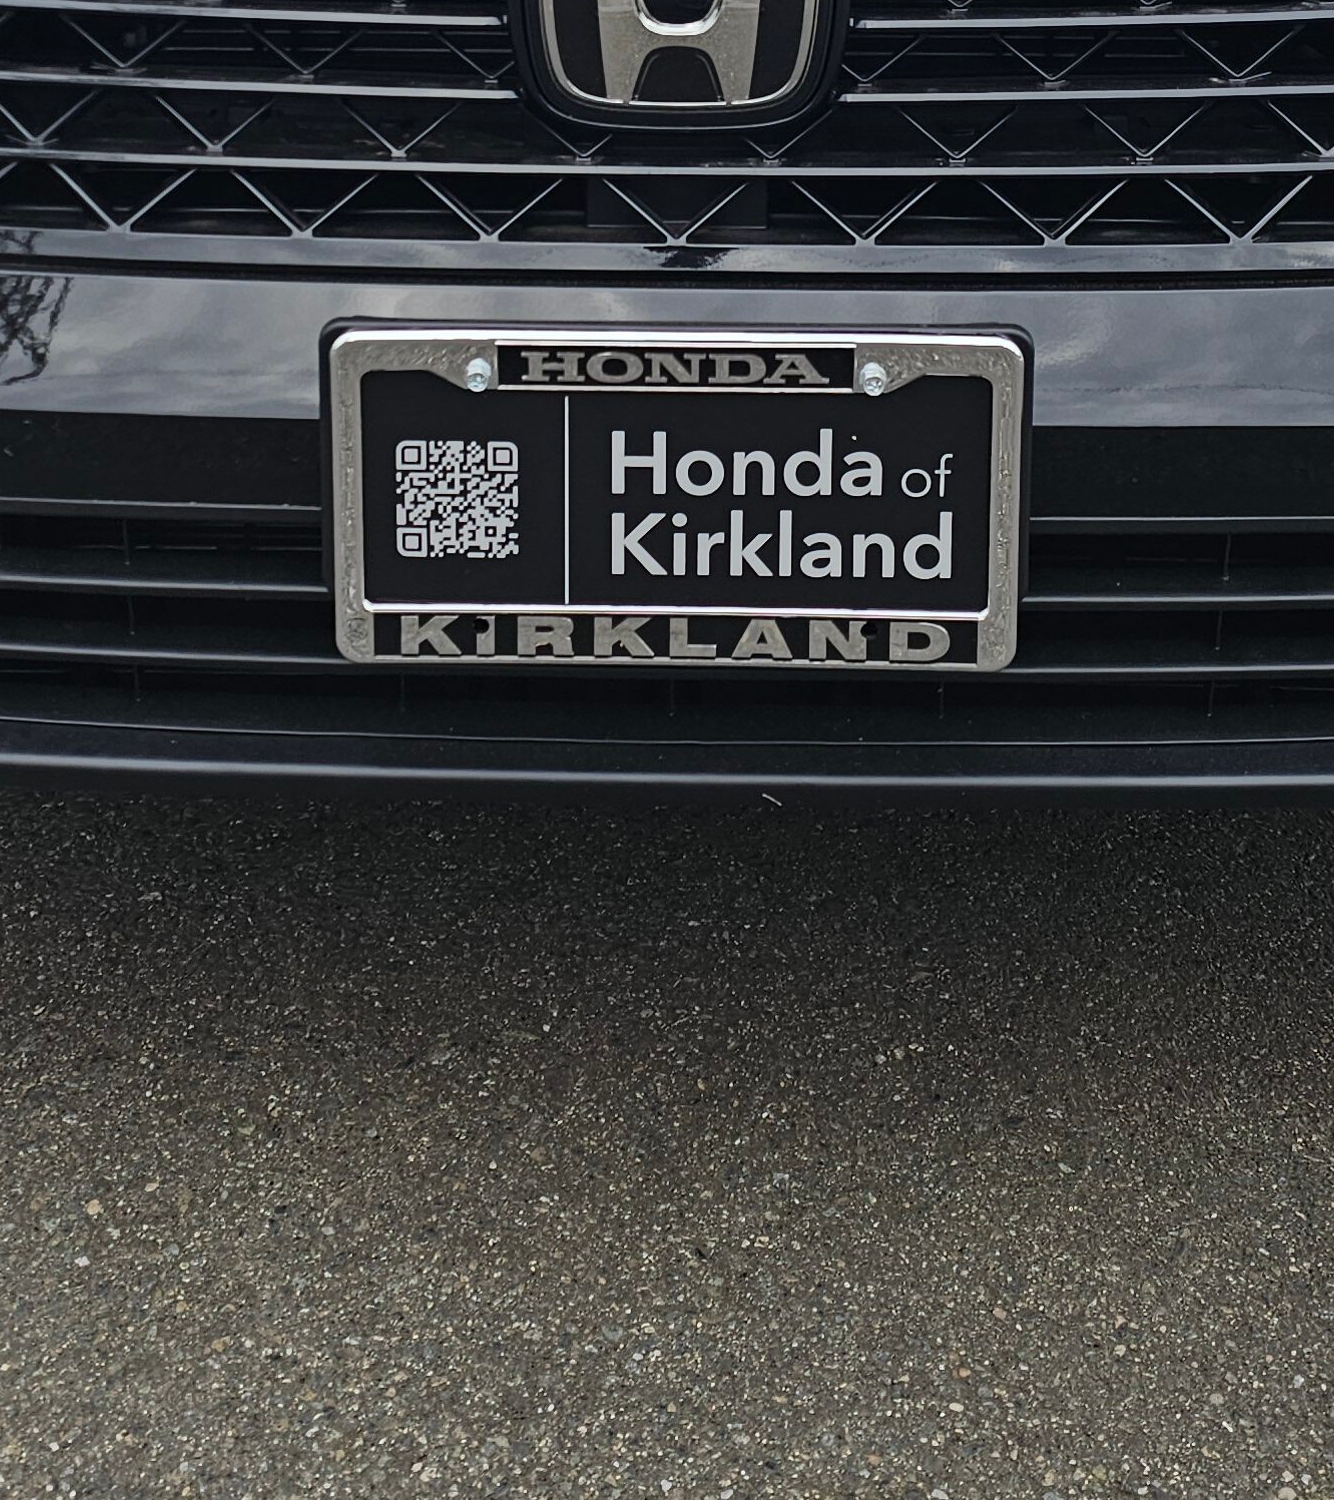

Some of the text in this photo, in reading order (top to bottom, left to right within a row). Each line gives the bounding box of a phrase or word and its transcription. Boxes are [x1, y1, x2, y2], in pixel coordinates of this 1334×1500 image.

[520, 350, 830, 386] HONDA
[611, 429, 953, 498] Honda of
[611, 510, 953, 579] Kirkland
[400, 615, 951, 662] KIRKLAND
